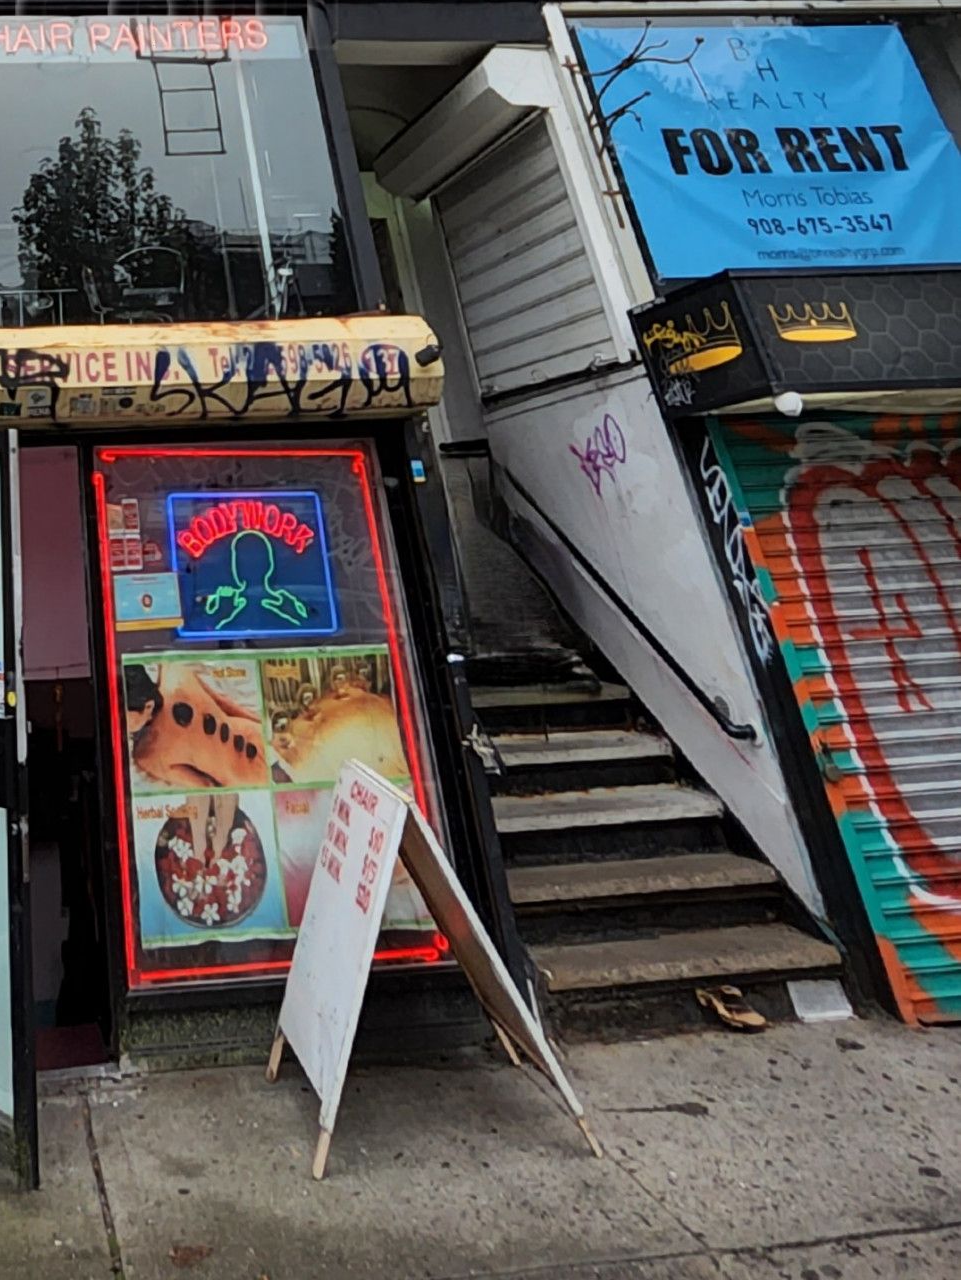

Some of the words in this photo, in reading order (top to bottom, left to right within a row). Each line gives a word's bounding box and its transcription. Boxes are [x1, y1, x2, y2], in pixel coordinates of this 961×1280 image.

[89, 19, 269, 55] PAINTERS
[755, 58, 779, 83] H
[660, 126, 773, 176] FOR
[774, 125, 910, 174] RENT
[741, 188, 806, 208] Morris
[810, 186, 874, 208] Tobias
[746, 213, 894, 237] 908-675-3547
[177, 499, 315, 559] BODYWORK
